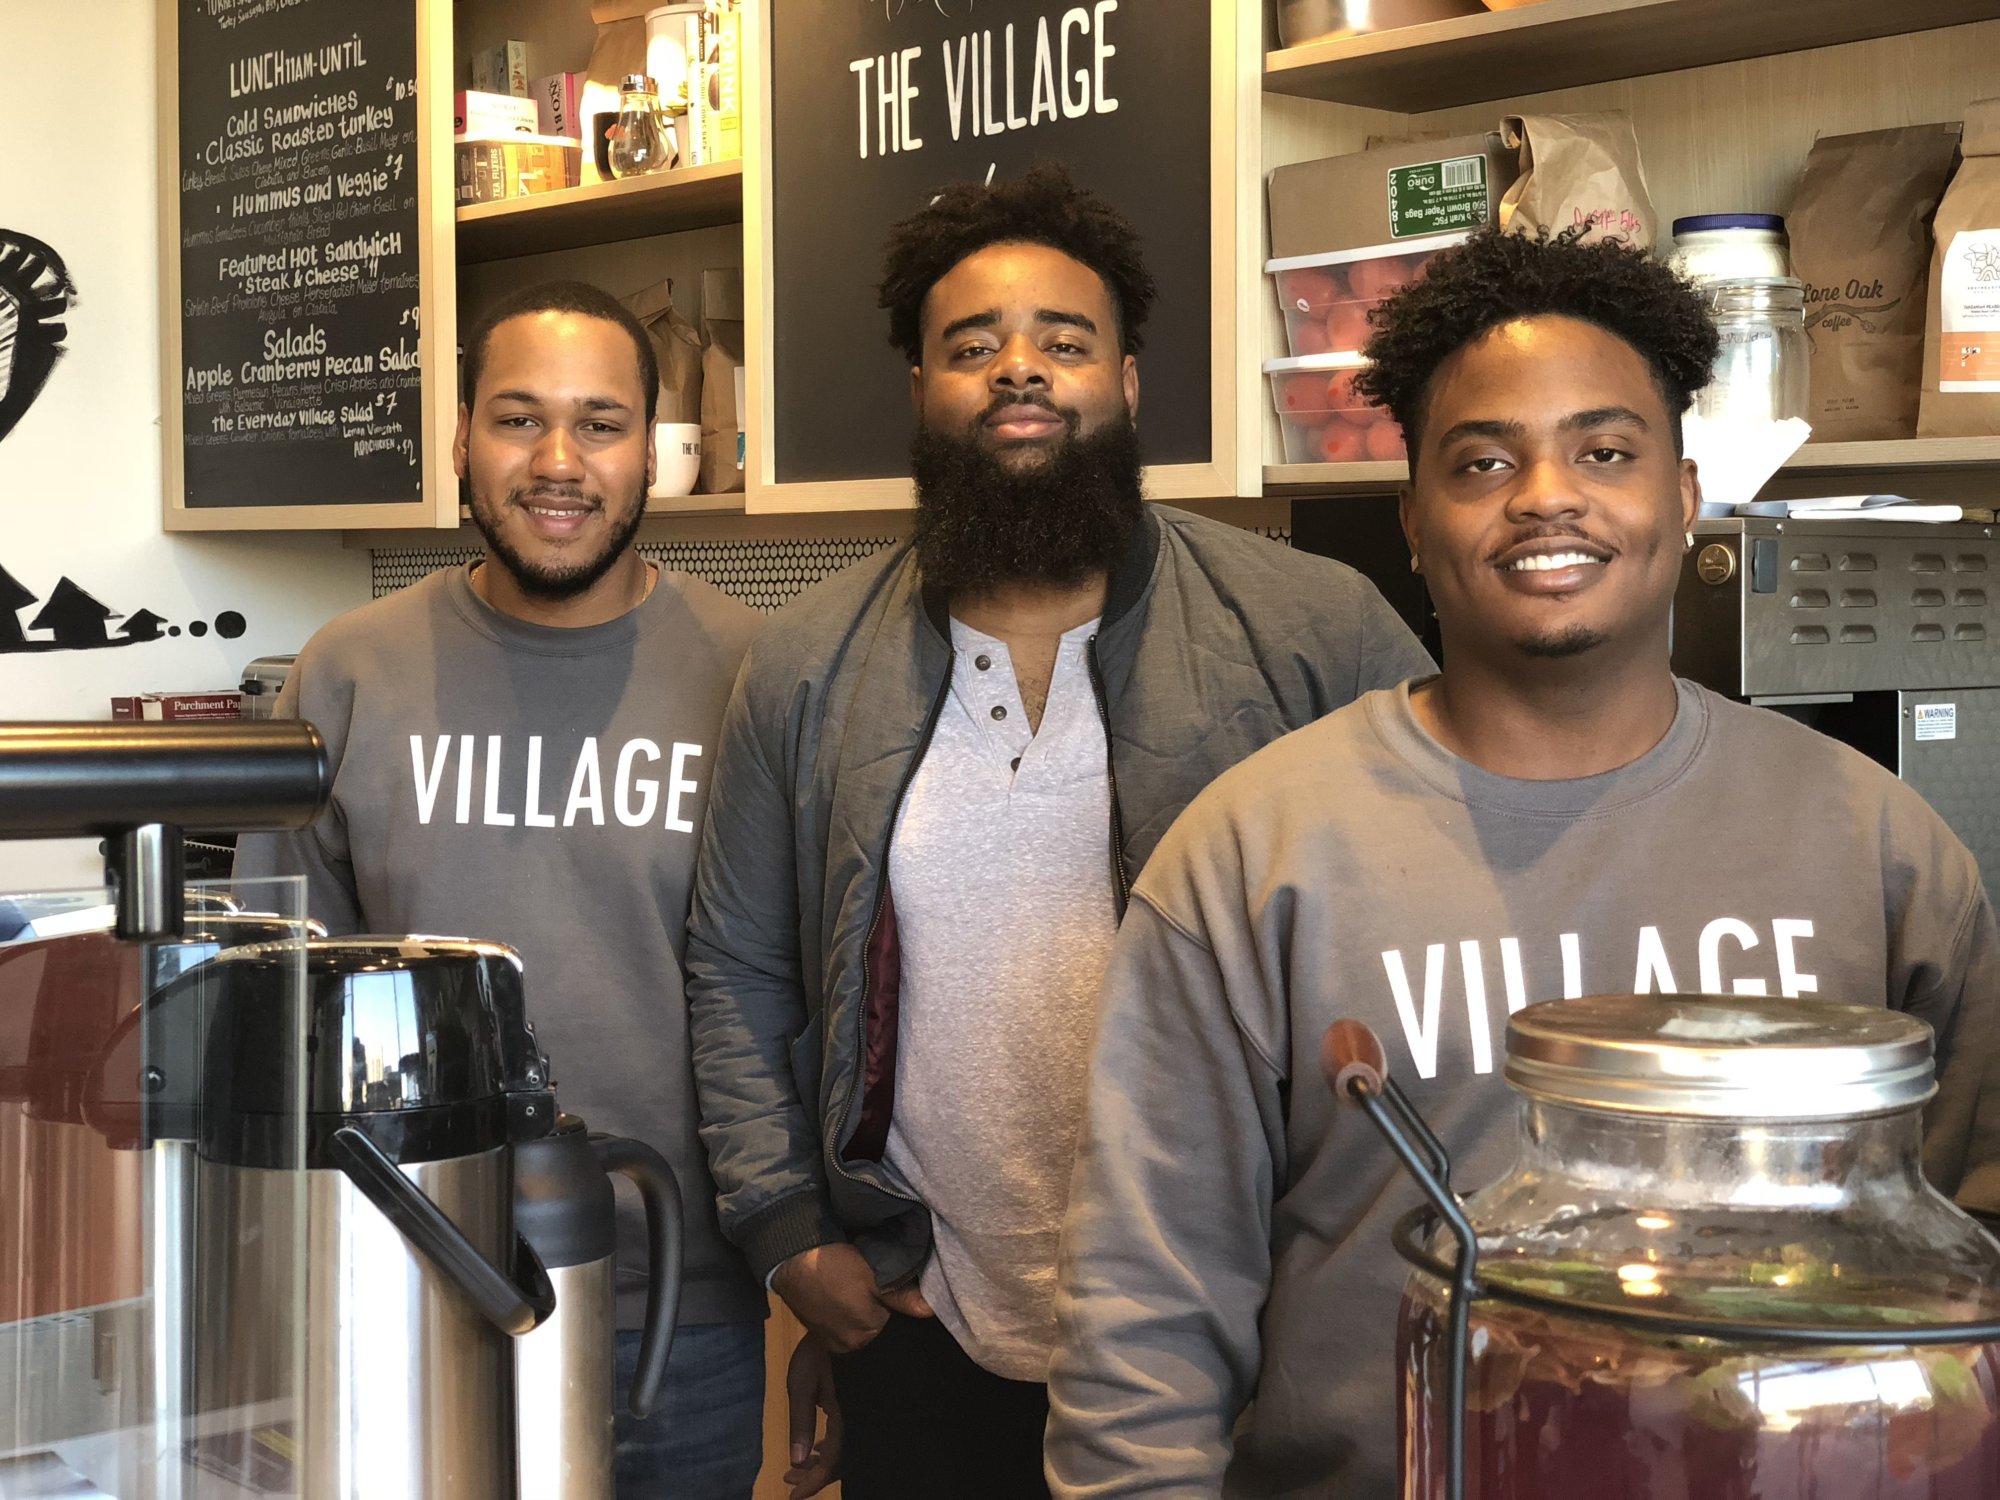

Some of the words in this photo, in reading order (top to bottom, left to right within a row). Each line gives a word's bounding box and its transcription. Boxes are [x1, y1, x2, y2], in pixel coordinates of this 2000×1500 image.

[230, 49, 285, 98] LUNCH
[849, 46, 923, 160] THE
[943, 0, 1119, 141] VILLAGE
[227, 107, 258, 138] Cold
[206, 134, 265, 166] Classic
[232, 185, 301, 218] Hummus
[303, 174, 333, 205] and
[337, 167, 389, 198] Veggie
[1407, 176, 1435, 188] DURO
[1404, 208, 1424, 219] Bags
[1424, 205, 1446, 216] Paper
[1447, 202, 1471, 212] Brown
[1449, 212, 1466, 224] Kraft
[218, 246, 287, 281] Featured
[293, 268, 304, 289] &
[1802, 283, 1840, 303] Lone
[1844, 278, 1884, 300] Oak
[1821, 315, 1852, 332] coffee
[263, 323, 328, 361] Salads
[186, 363, 234, 393] Apple
[241, 357, 320, 385] Cranberry
[379, 336, 422, 372] Salad
[237, 411, 298, 431] Everyday
[298, 407, 337, 426] Village
[340, 401, 375, 424] Salad
[374, 390, 398, 416] $7
[682, 442, 692, 456] THE
[173, 700, 225, 711] Parchment
[1924, 707, 1954, 719] WARNING
[409, 735, 703, 833] VILLAGE
